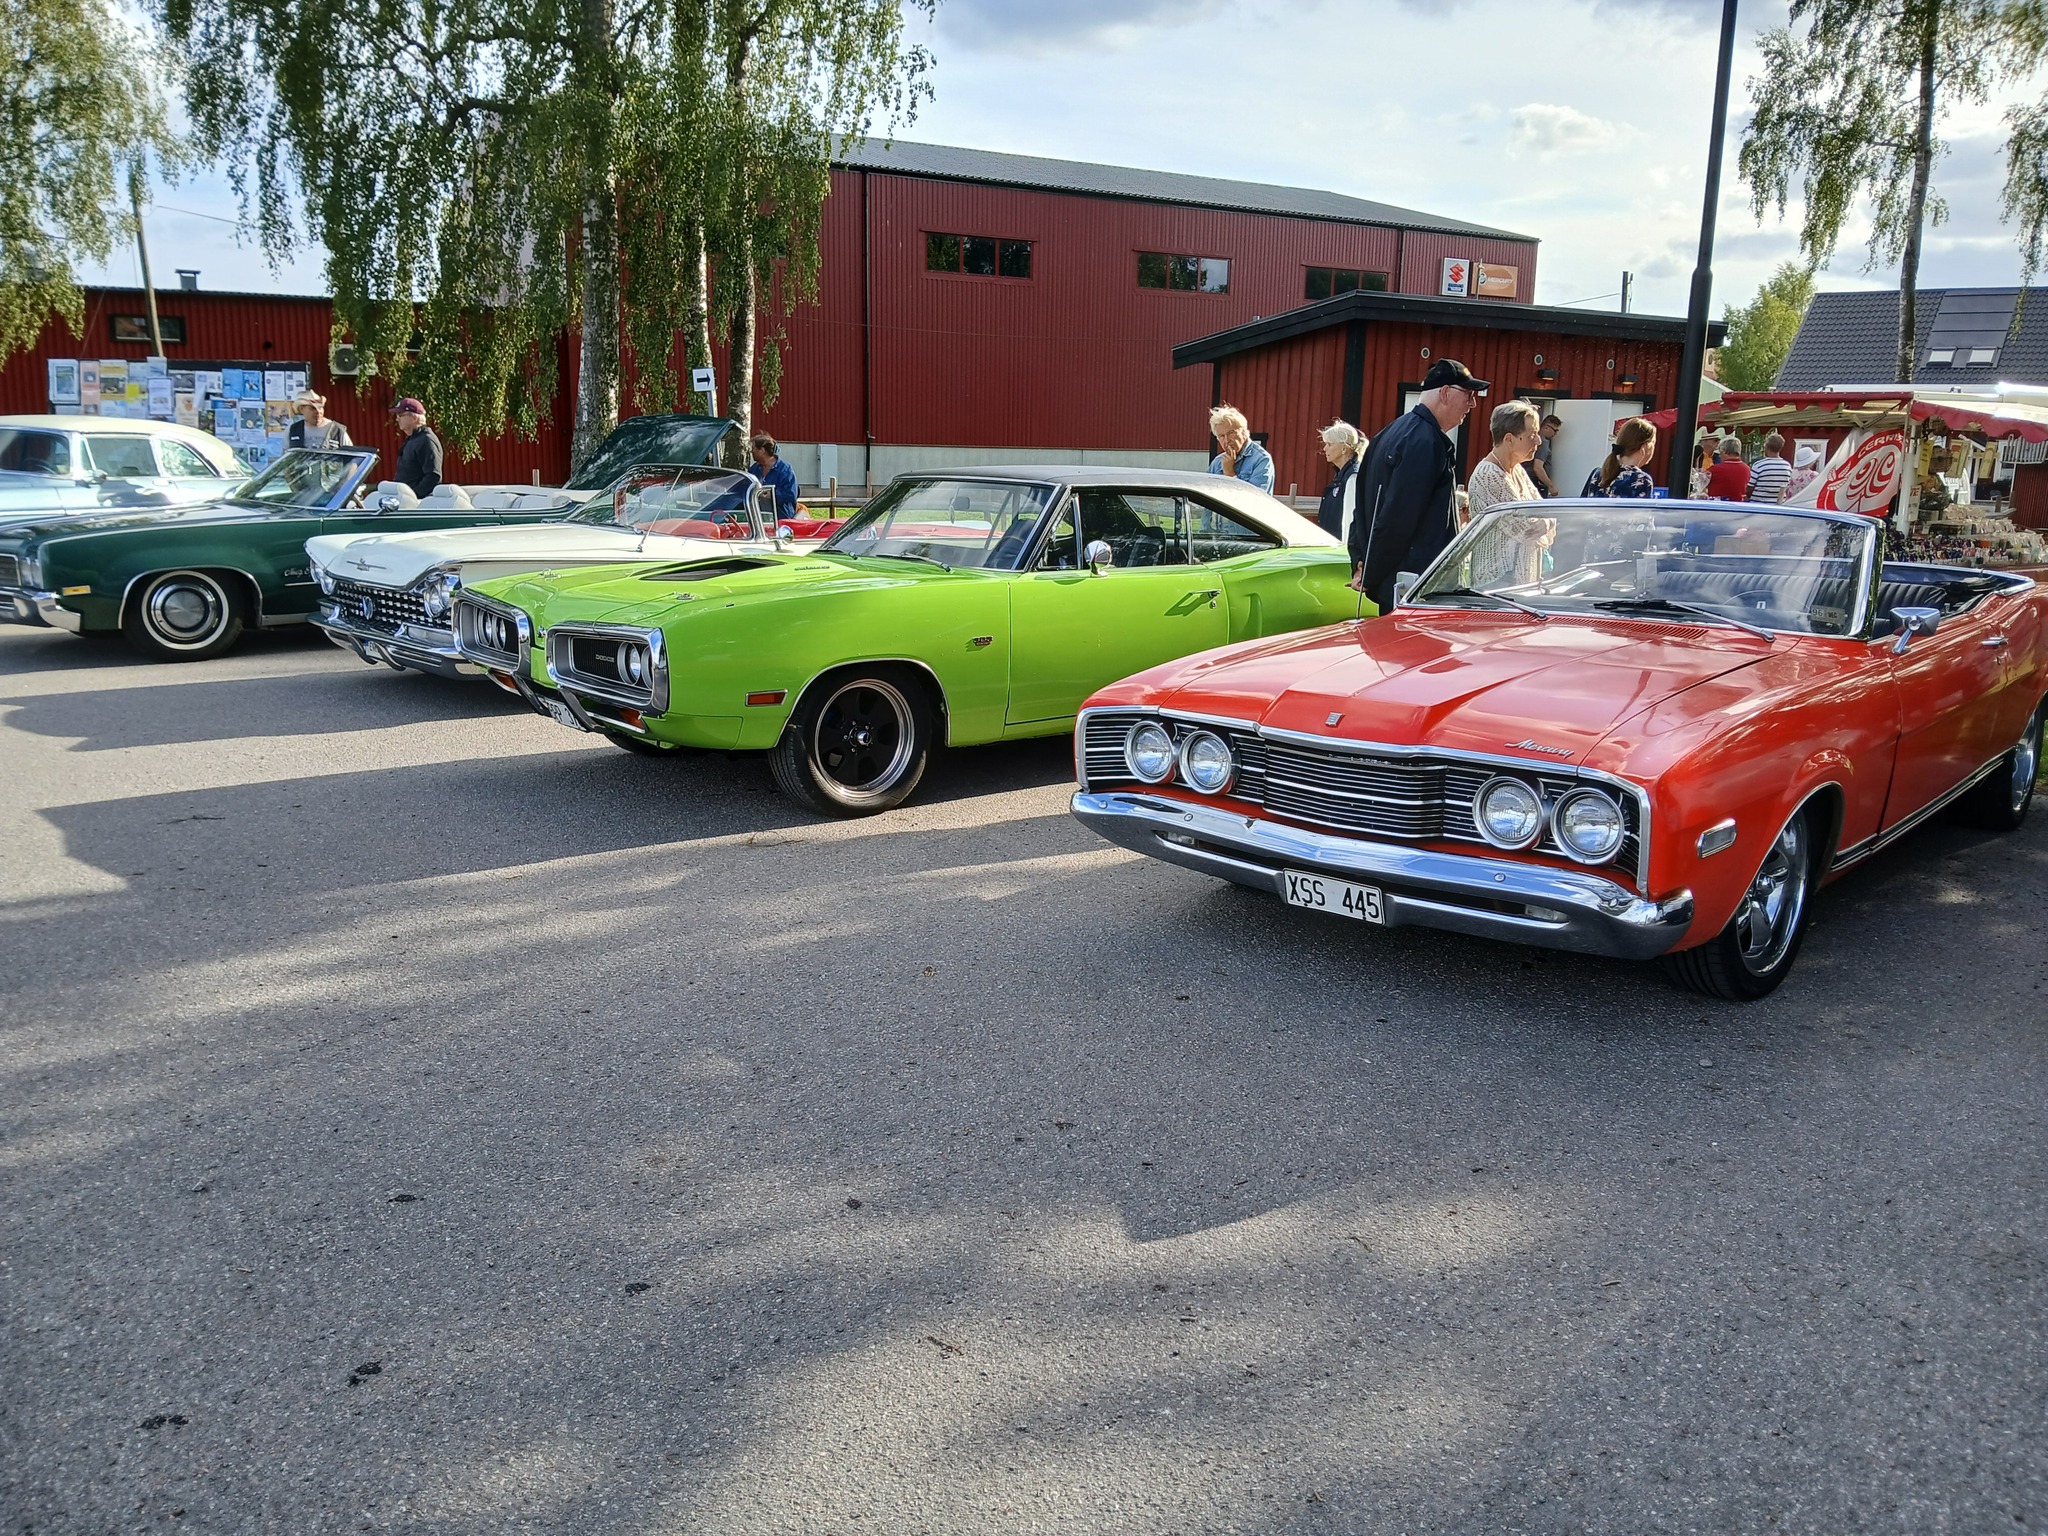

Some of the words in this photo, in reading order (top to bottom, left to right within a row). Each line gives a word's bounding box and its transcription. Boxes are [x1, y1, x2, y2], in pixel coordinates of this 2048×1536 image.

[1504, 738, 1575, 760] Mercury
[1287, 874, 1326, 907] XSS
[1342, 887, 1380, 919] 445
